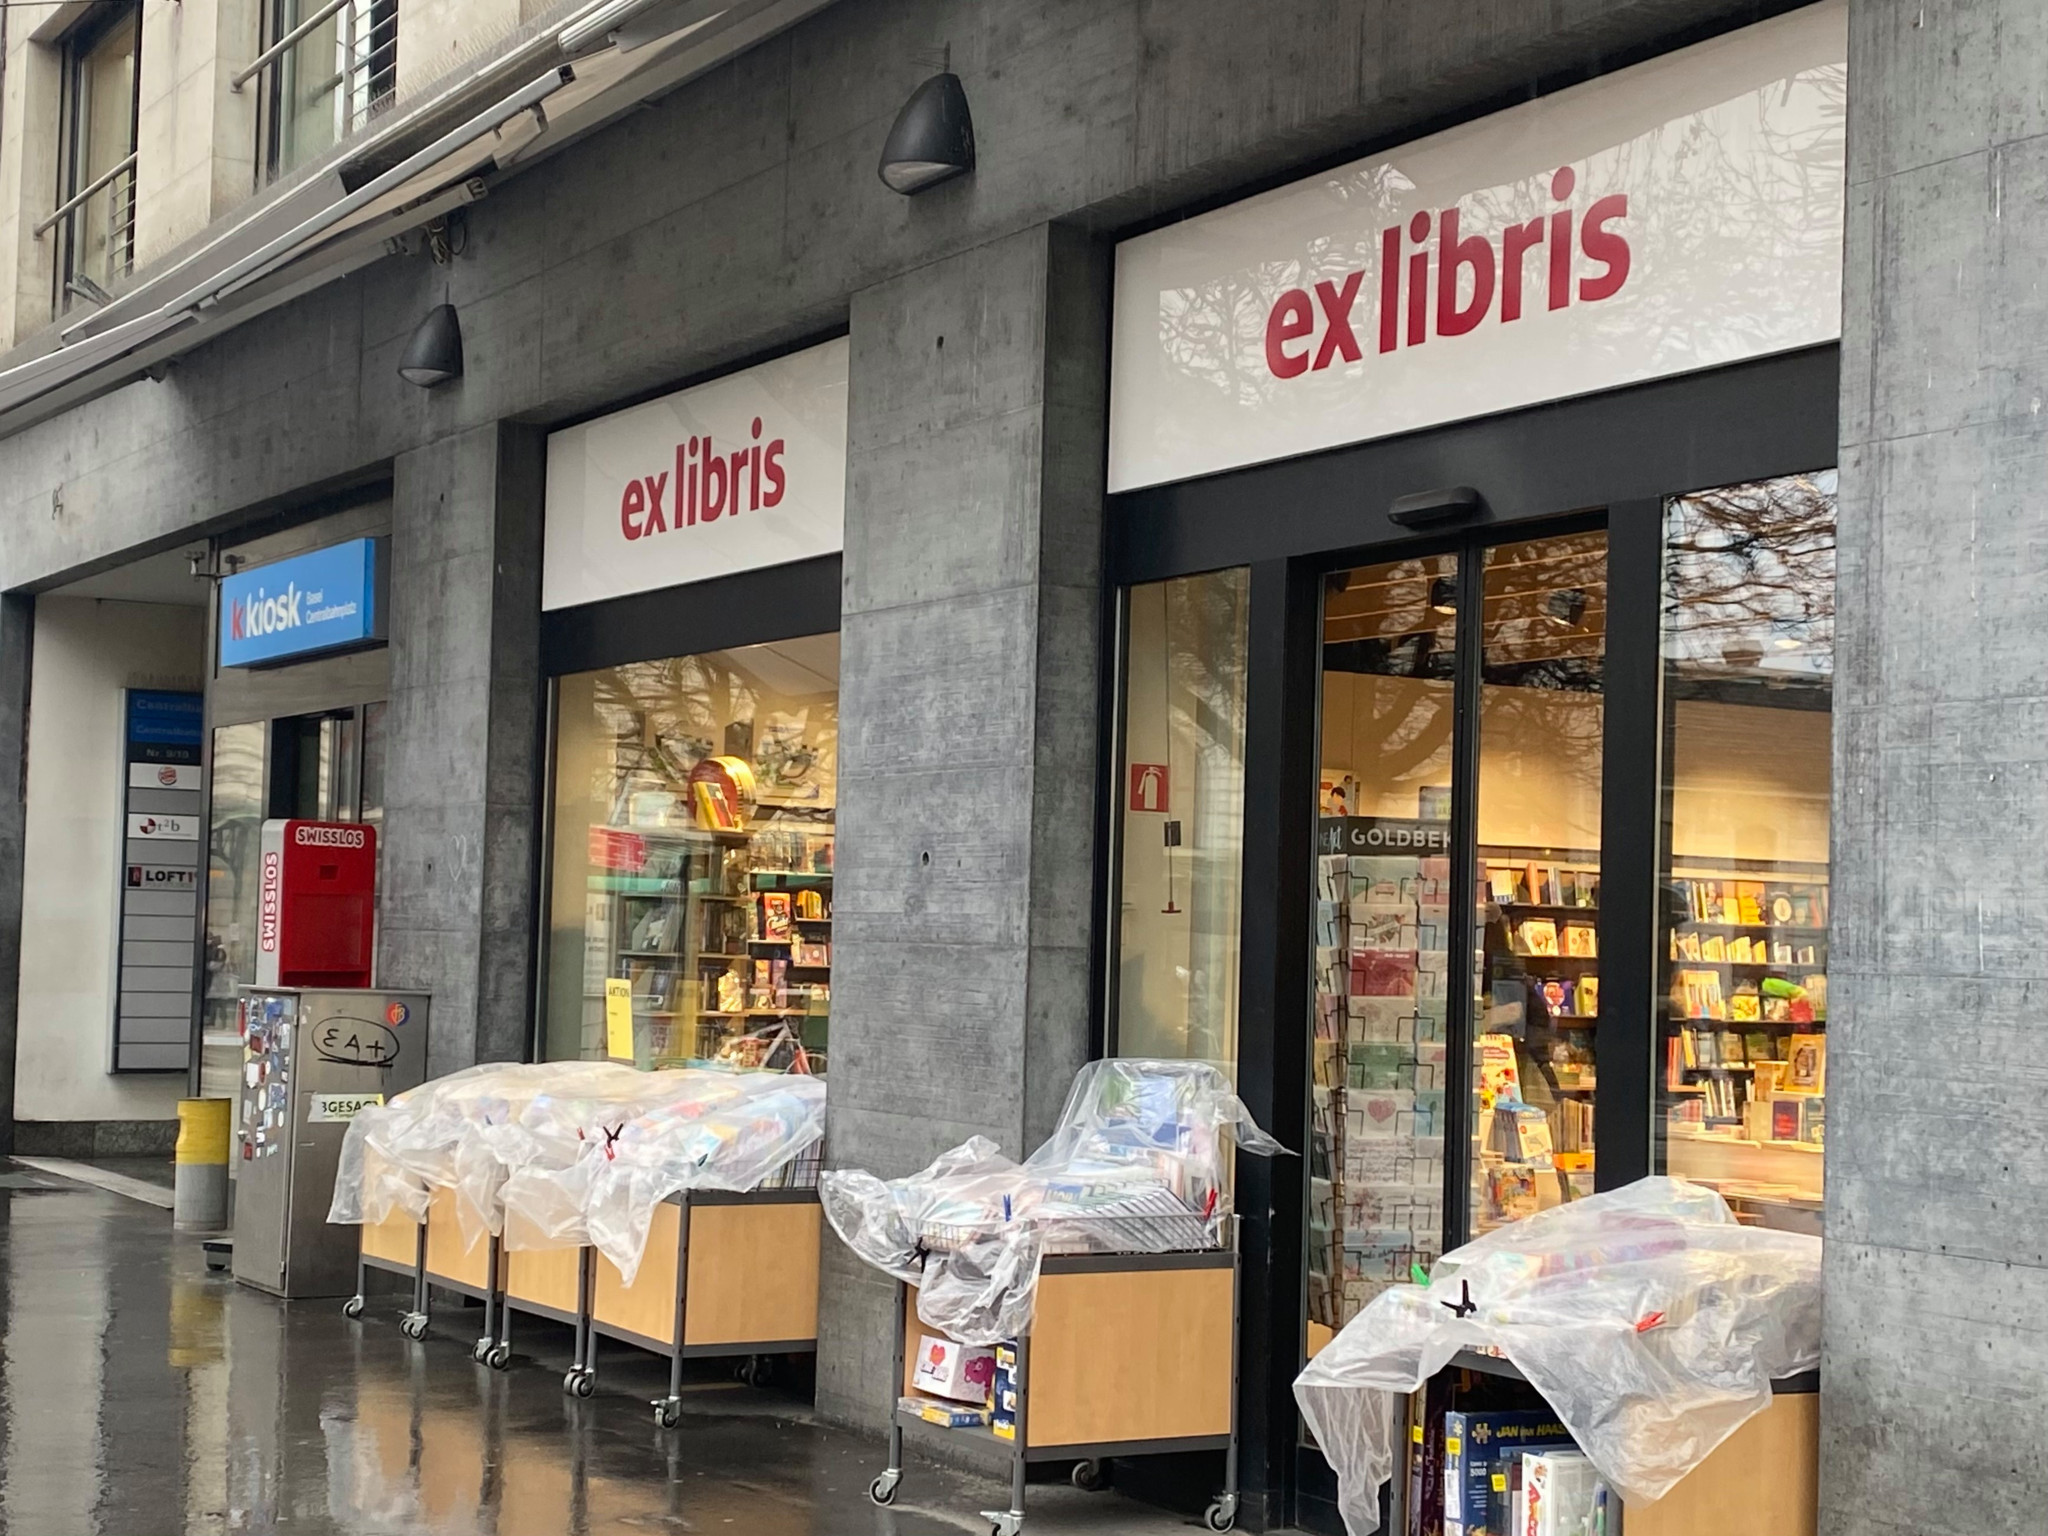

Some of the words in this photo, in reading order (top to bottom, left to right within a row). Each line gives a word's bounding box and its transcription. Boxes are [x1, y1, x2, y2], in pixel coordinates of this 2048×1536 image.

[1265, 270, 1366, 379] ex
[1379, 166, 1631, 354] libris
[621, 471, 669, 541] ex
[674, 416, 786, 529] libris
[246, 580, 302, 638] kiosk
[296, 826, 364, 848] SWISSLOS
[262, 852, 278, 952] SWISSLOS
